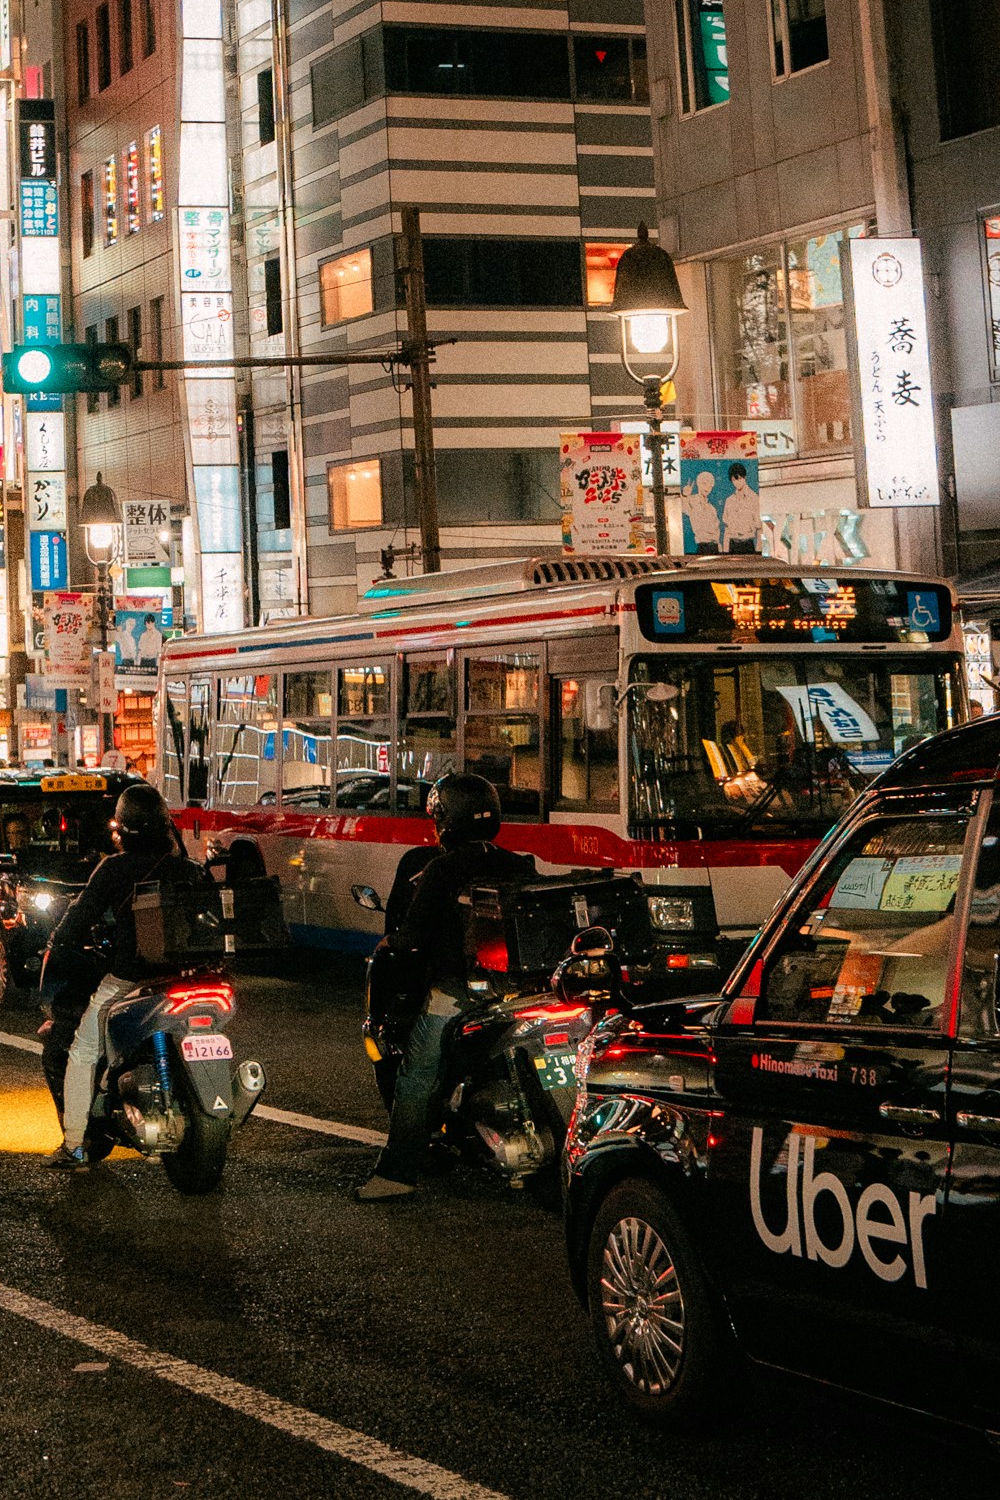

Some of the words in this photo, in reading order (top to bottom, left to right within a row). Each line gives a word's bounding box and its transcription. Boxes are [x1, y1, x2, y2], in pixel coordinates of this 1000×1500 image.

[25, 298, 39, 341] 内科
[871, 351, 884, 393] うどん
[886, 316, 921, 406] 蕎麦
[584, 487, 622, 504] 2025
[126, 503, 167, 526] 整体
[731, 586, 857, 619] 回送
[194, 1046, 230, 1058] 12166
[814, 1062, 838, 1083] Taxi
[851, 1066, 877, 1087] 738
[750, 1126, 937, 1289] Uber
